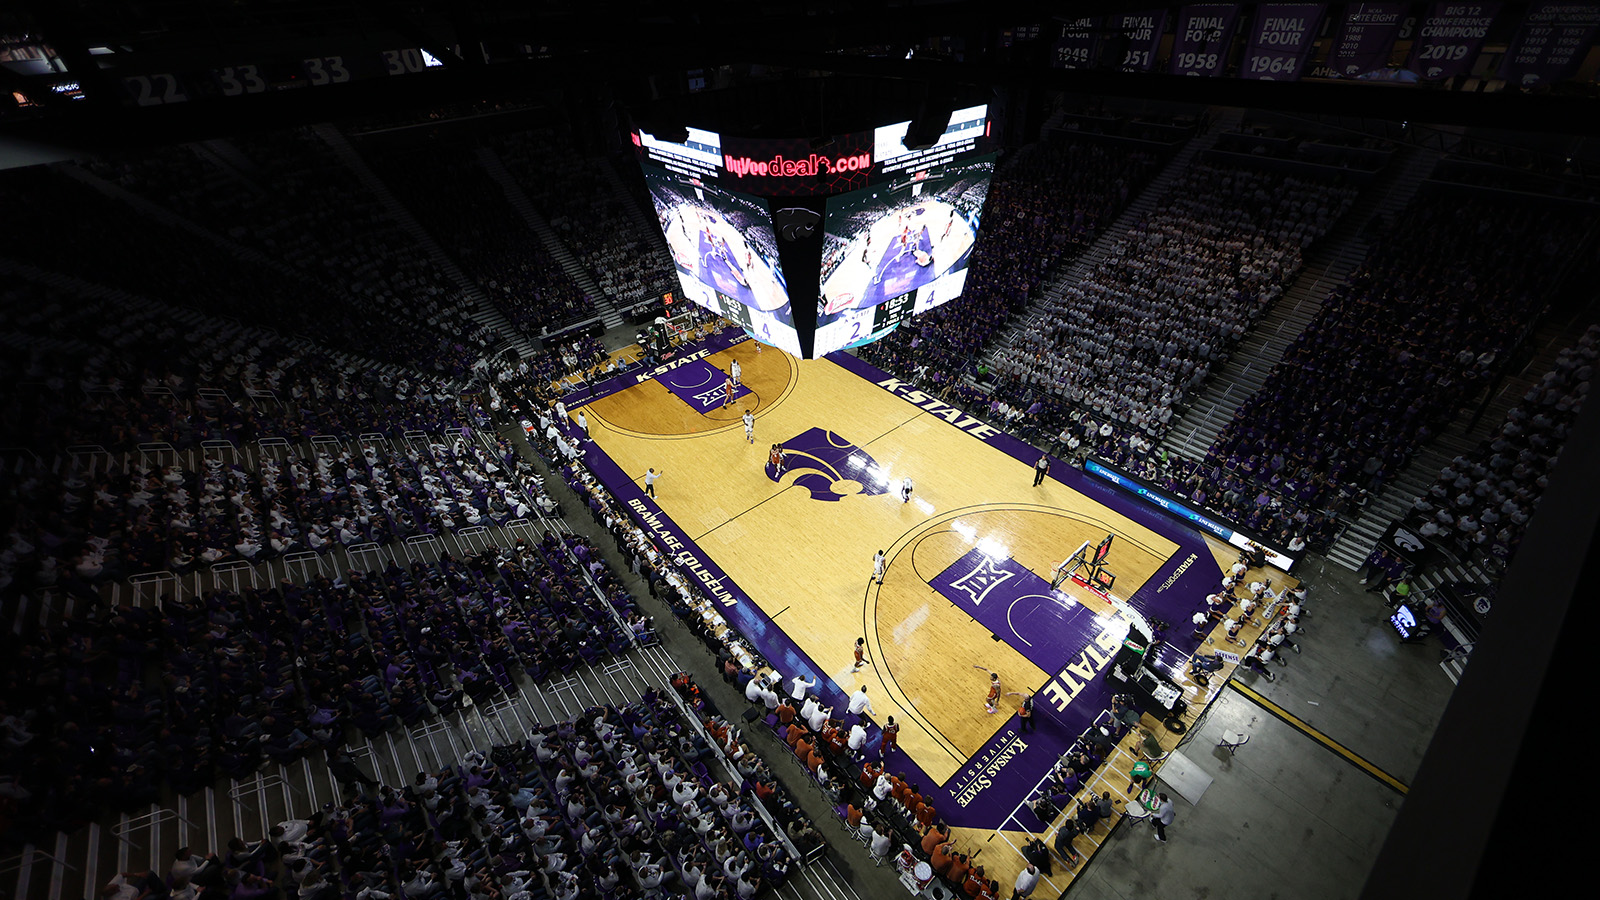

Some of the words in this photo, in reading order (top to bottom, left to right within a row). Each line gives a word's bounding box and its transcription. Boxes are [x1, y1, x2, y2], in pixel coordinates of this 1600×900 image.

[1372, 14, 1398, 22] EIGHT
[1445, 7, 1466, 16] BIG
[1468, 6, 1482, 16] 12
[1122, 17, 1155, 29] FINAL
[1188, 17, 1224, 30] FINAL
[1263, 18, 1305, 31] FINAL
[1425, 17, 1494, 26] CONFERENCE
[1259, 32, 1302, 45] FOUR
[1420, 26, 1488, 39] CHAMPIONS
[1419, 45, 1469, 60] 2019
[382, 48, 423, 76] 30
[1178, 53, 1219, 70] 1958
[1250, 56, 1297, 74] 1964
[220, 64, 265, 96] 33
[304, 56, 350, 87] 33
[124, 73, 189, 107] 22
[925, 289, 935, 306] 4
[763, 323, 771, 339] 4
[850, 321, 861, 340] 2
[636, 349, 711, 382] K-STATE
[877, 378, 1002, 440] K-STATE
[627, 498, 684, 551] BRAMLAGE
[677, 550, 738, 607] COLISEUM
[1043, 620, 1126, 713] STATE
[949, 730, 1015, 797] UNIVERSITY
